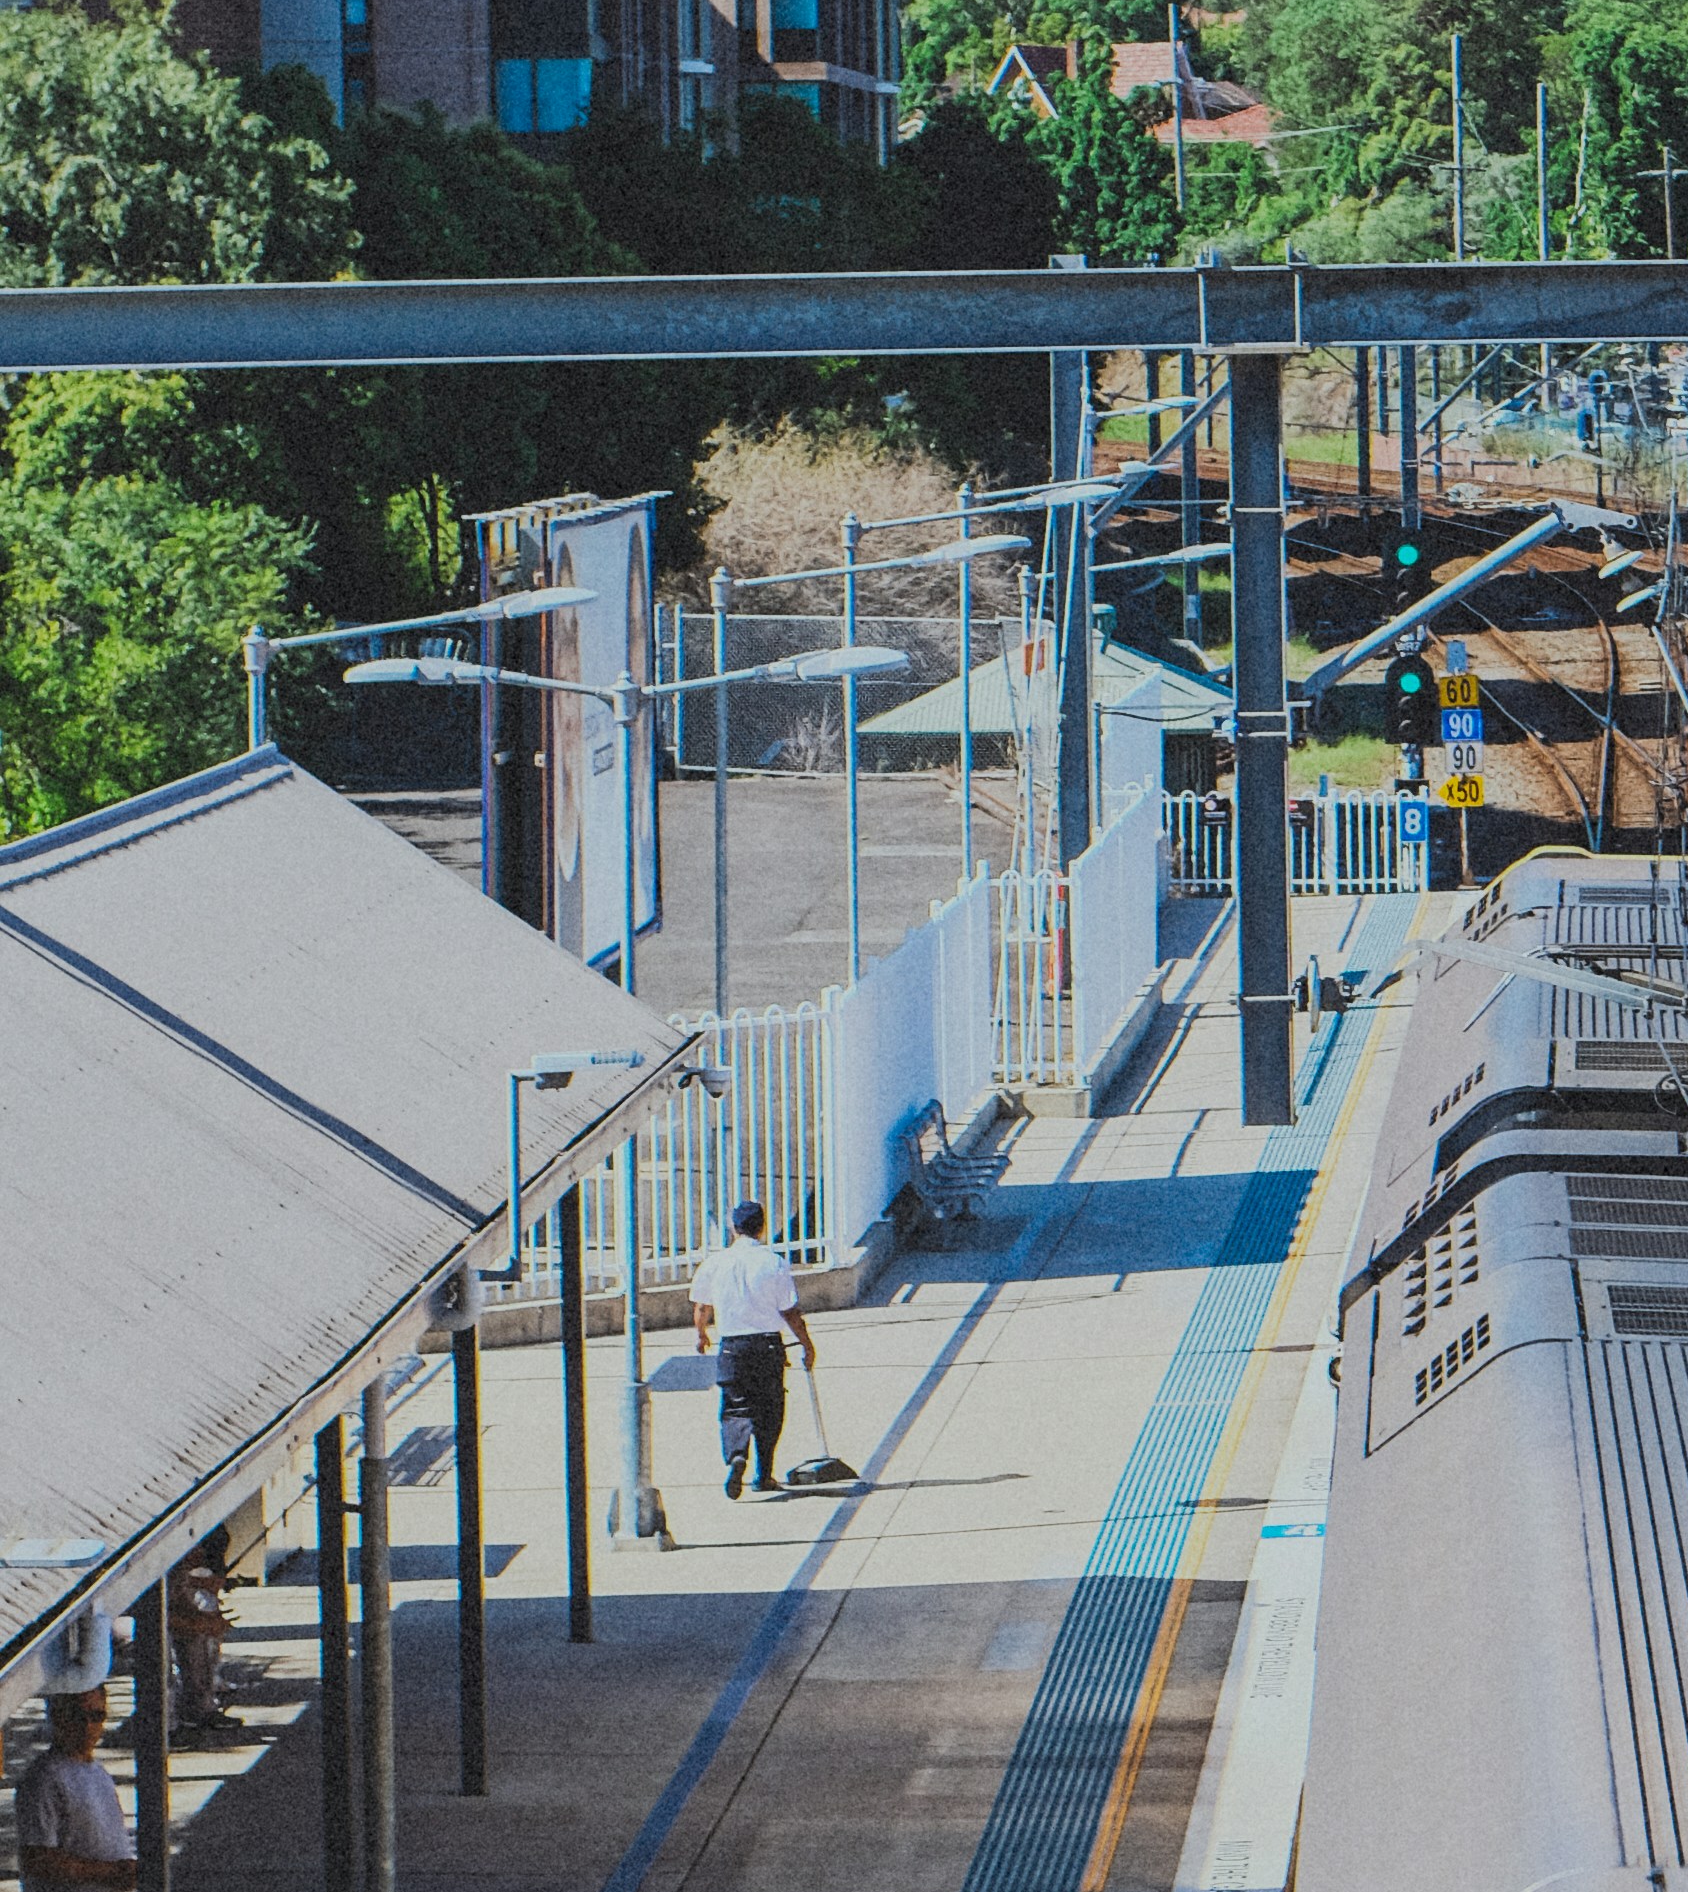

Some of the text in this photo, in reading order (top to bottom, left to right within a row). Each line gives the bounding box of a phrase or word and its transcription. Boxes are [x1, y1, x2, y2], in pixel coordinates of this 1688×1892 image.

[1446, 678, 1471, 703] 60
[1449, 712, 1473, 738] 90
[1453, 744, 1476, 769] 90
[1404, 808, 1421, 834] 8
